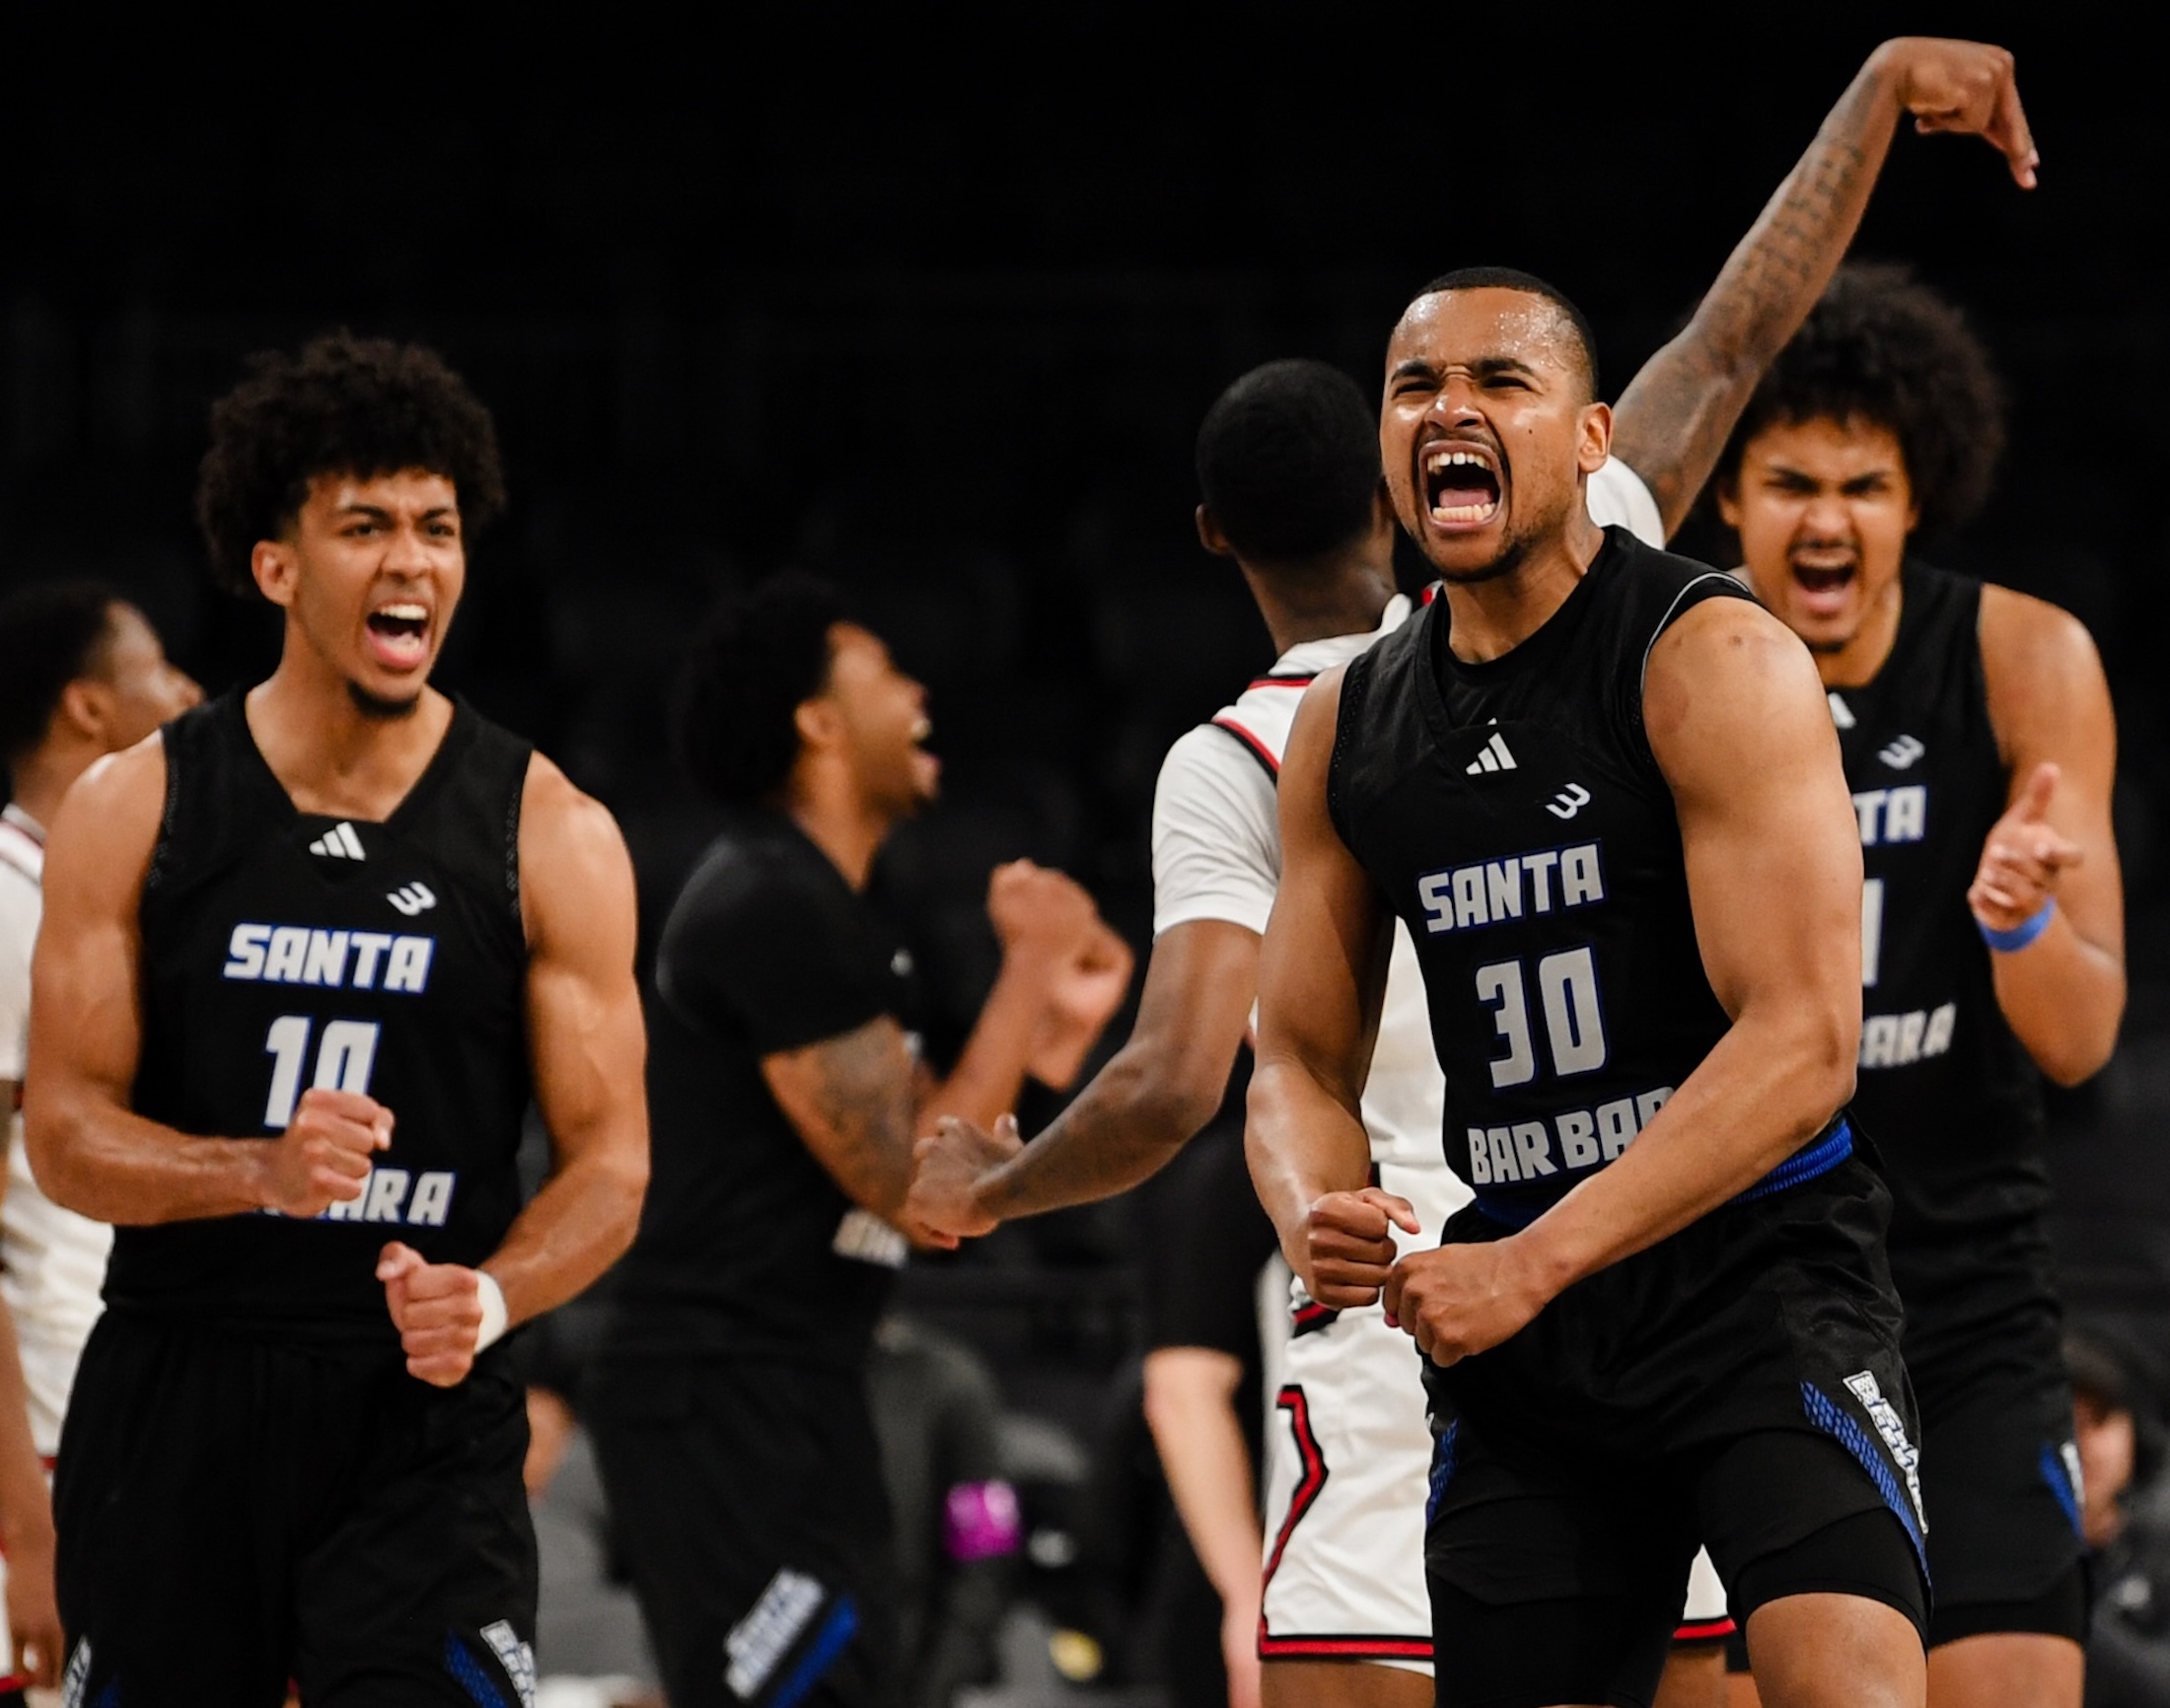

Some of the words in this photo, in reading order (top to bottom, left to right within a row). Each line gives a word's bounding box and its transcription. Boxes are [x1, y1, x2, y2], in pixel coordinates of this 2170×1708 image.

[1417, 842, 1606, 933] SANTA
[222, 921, 437, 994] SANTA
[1475, 946, 1607, 1089] 30
[1467, 1086, 1675, 1185] BARBA
